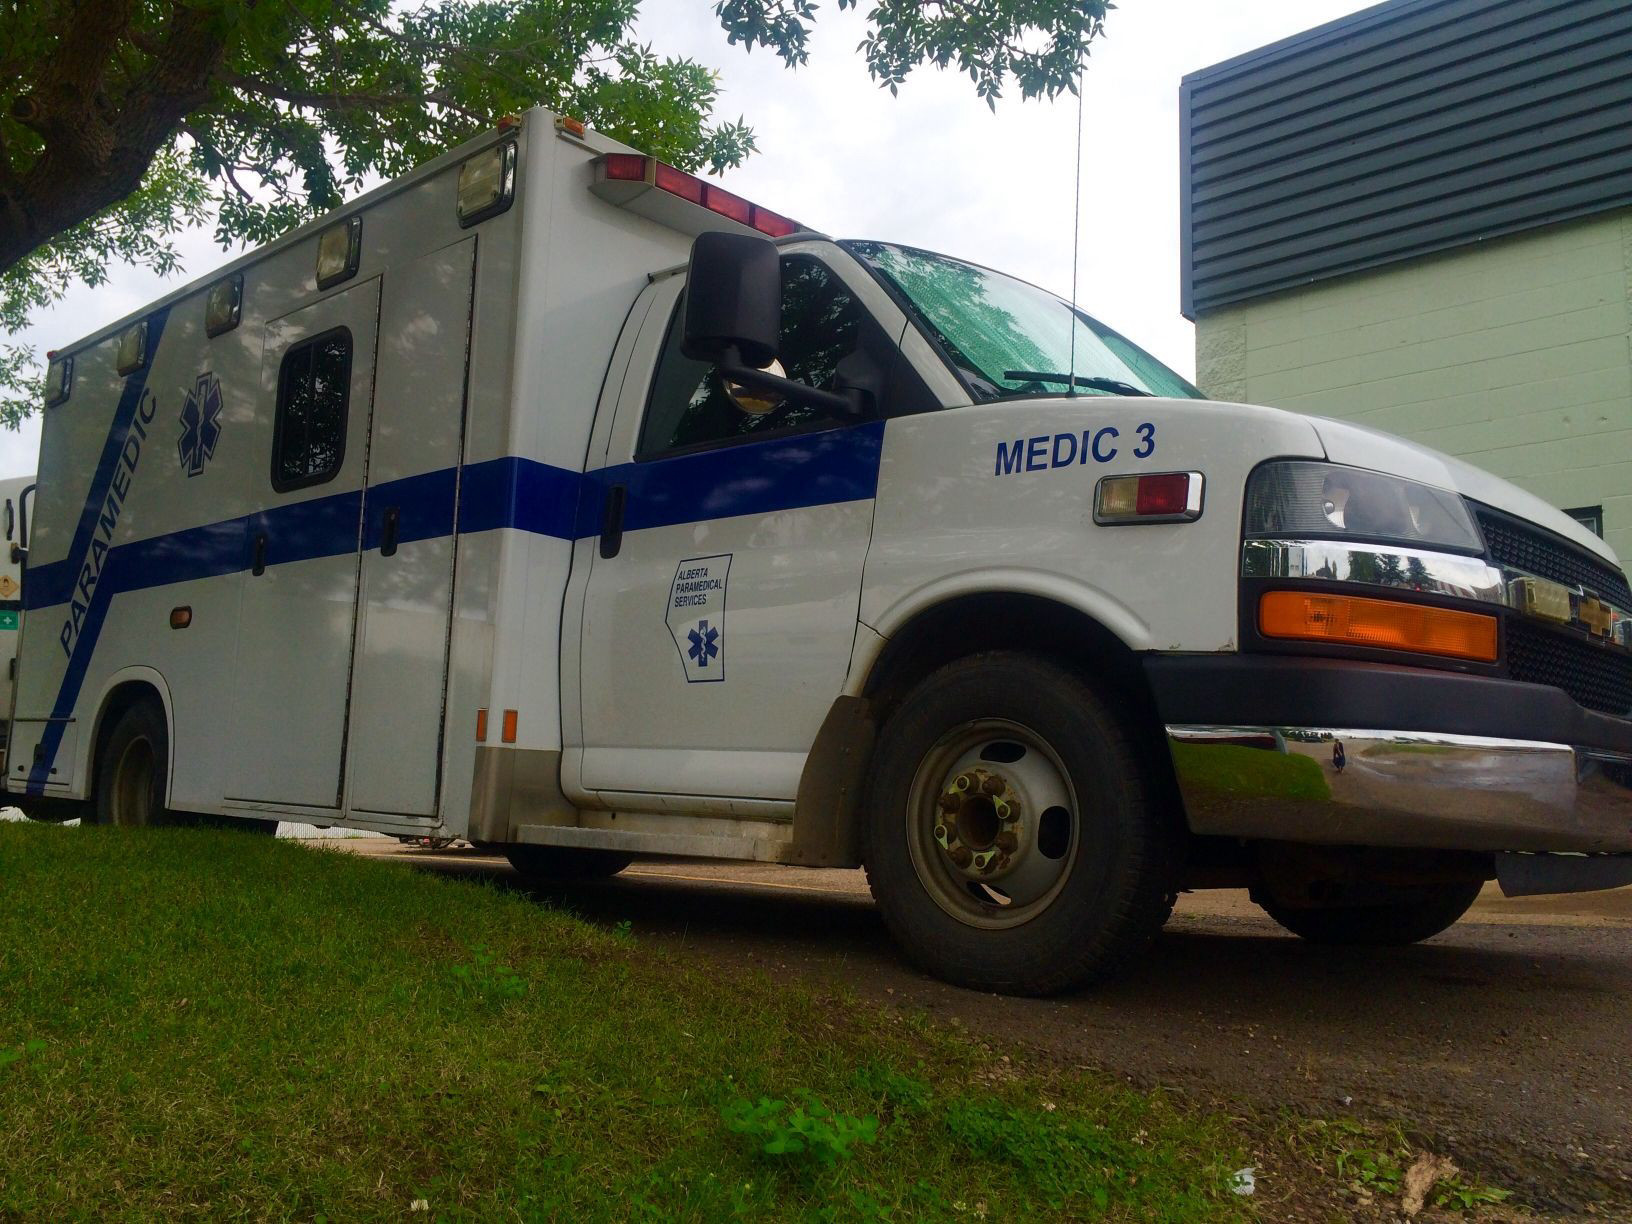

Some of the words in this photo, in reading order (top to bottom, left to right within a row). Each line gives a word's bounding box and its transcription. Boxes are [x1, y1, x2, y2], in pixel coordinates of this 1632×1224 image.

[994, 426, 1120, 477] MEDIC
[1133, 422, 1156, 459] 3
[60, 388, 157, 658] PARAMEDIC
[678, 568, 708, 581] ALBERTA
[675, 579, 723, 594] PARAMEDICAL
[674, 594, 707, 608] SERVICES
